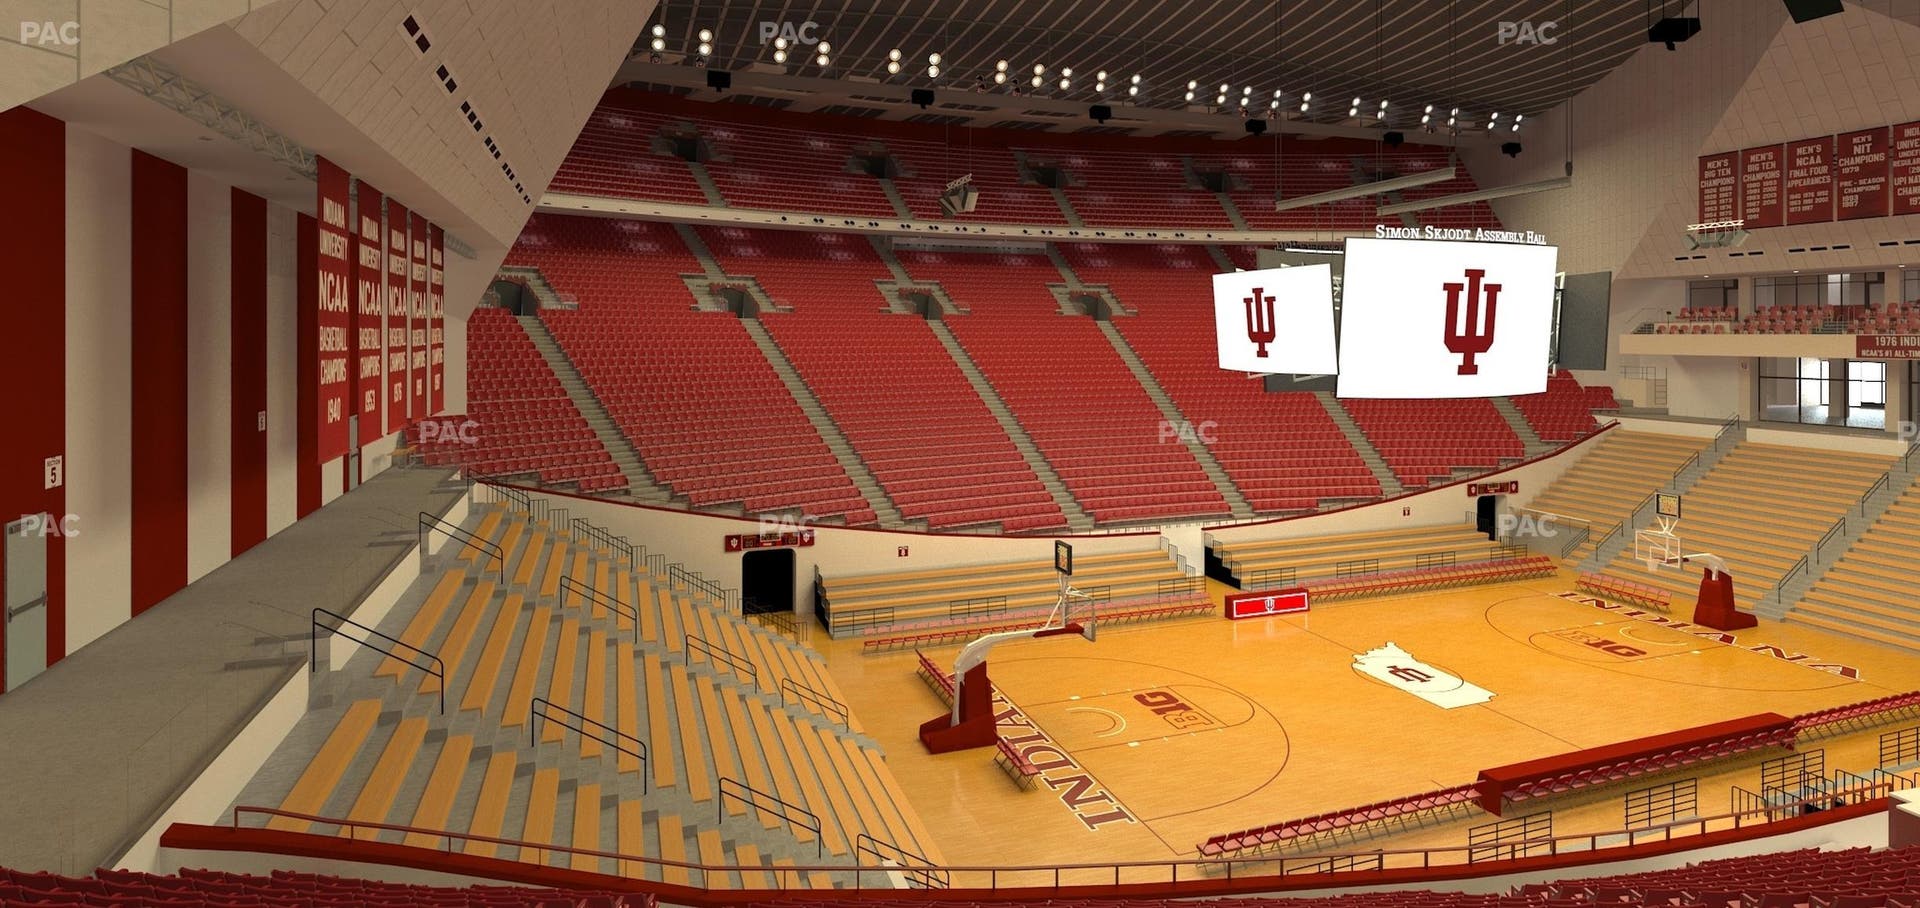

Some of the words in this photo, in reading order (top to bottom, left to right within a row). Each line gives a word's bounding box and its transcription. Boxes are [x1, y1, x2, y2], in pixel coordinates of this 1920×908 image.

[1852, 134, 1872, 144] MEN'S
[1750, 152, 1773, 163] MEN'S
[1796, 144, 1822, 156] MEN'S
[1853, 143, 1872, 155] NIT
[1706, 158, 1728, 169] MEN'S
[1747, 163, 1760, 173] BIG
[1762, 161, 1776, 170] TEN
[1796, 155, 1821, 167] NCAA
[1839, 152, 1885, 167] CHAMPIONS
[1704, 170, 1716, 179] BIG
[1718, 167, 1731, 177] TEN
[1743, 170, 1780, 183] CHAMPIONS
[1789, 168, 1808, 179] FINAL
[1809, 165, 1828, 176] FOUR
[1700, 176, 1735, 188] CHAMPIONS
[1787, 175, 1831, 188] APPEARANCES
[1844, 184, 1880, 194] CHAMPIONS
[323, 196, 345, 230] INDIANA
[1425, 224, 1471, 240] SKJODT
[1475, 227, 1524, 244] ASSEMBLY
[1526, 230, 1547, 245] HALL
[320, 228, 348, 261] UNIVERSITY
[319, 269, 348, 313] NCAA
[359, 279, 382, 316] NCAA
[388, 286, 407, 316] NCAA
[412, 291, 426, 318] NCAA
[431, 292, 443, 318] NCAA
[319, 326, 347, 351] BASKETBALL
[359, 328, 381, 350] BASKETBALL
[1875, 336, 1897, 347] 1976
[1900, 336, 1920, 347] INDI
[1861, 349, 1884, 357] NCAA'S
[320, 358, 346, 385] CHAMPIONS
[360, 356, 380, 379] CHAMPIONS
[365, 389, 375, 412] 1953
[327, 397, 341, 424] 1940
[50, 466, 57, 484] 5
[1556, 591, 1866, 681] INDIANA
[992, 684, 1136, 832] INDIA
